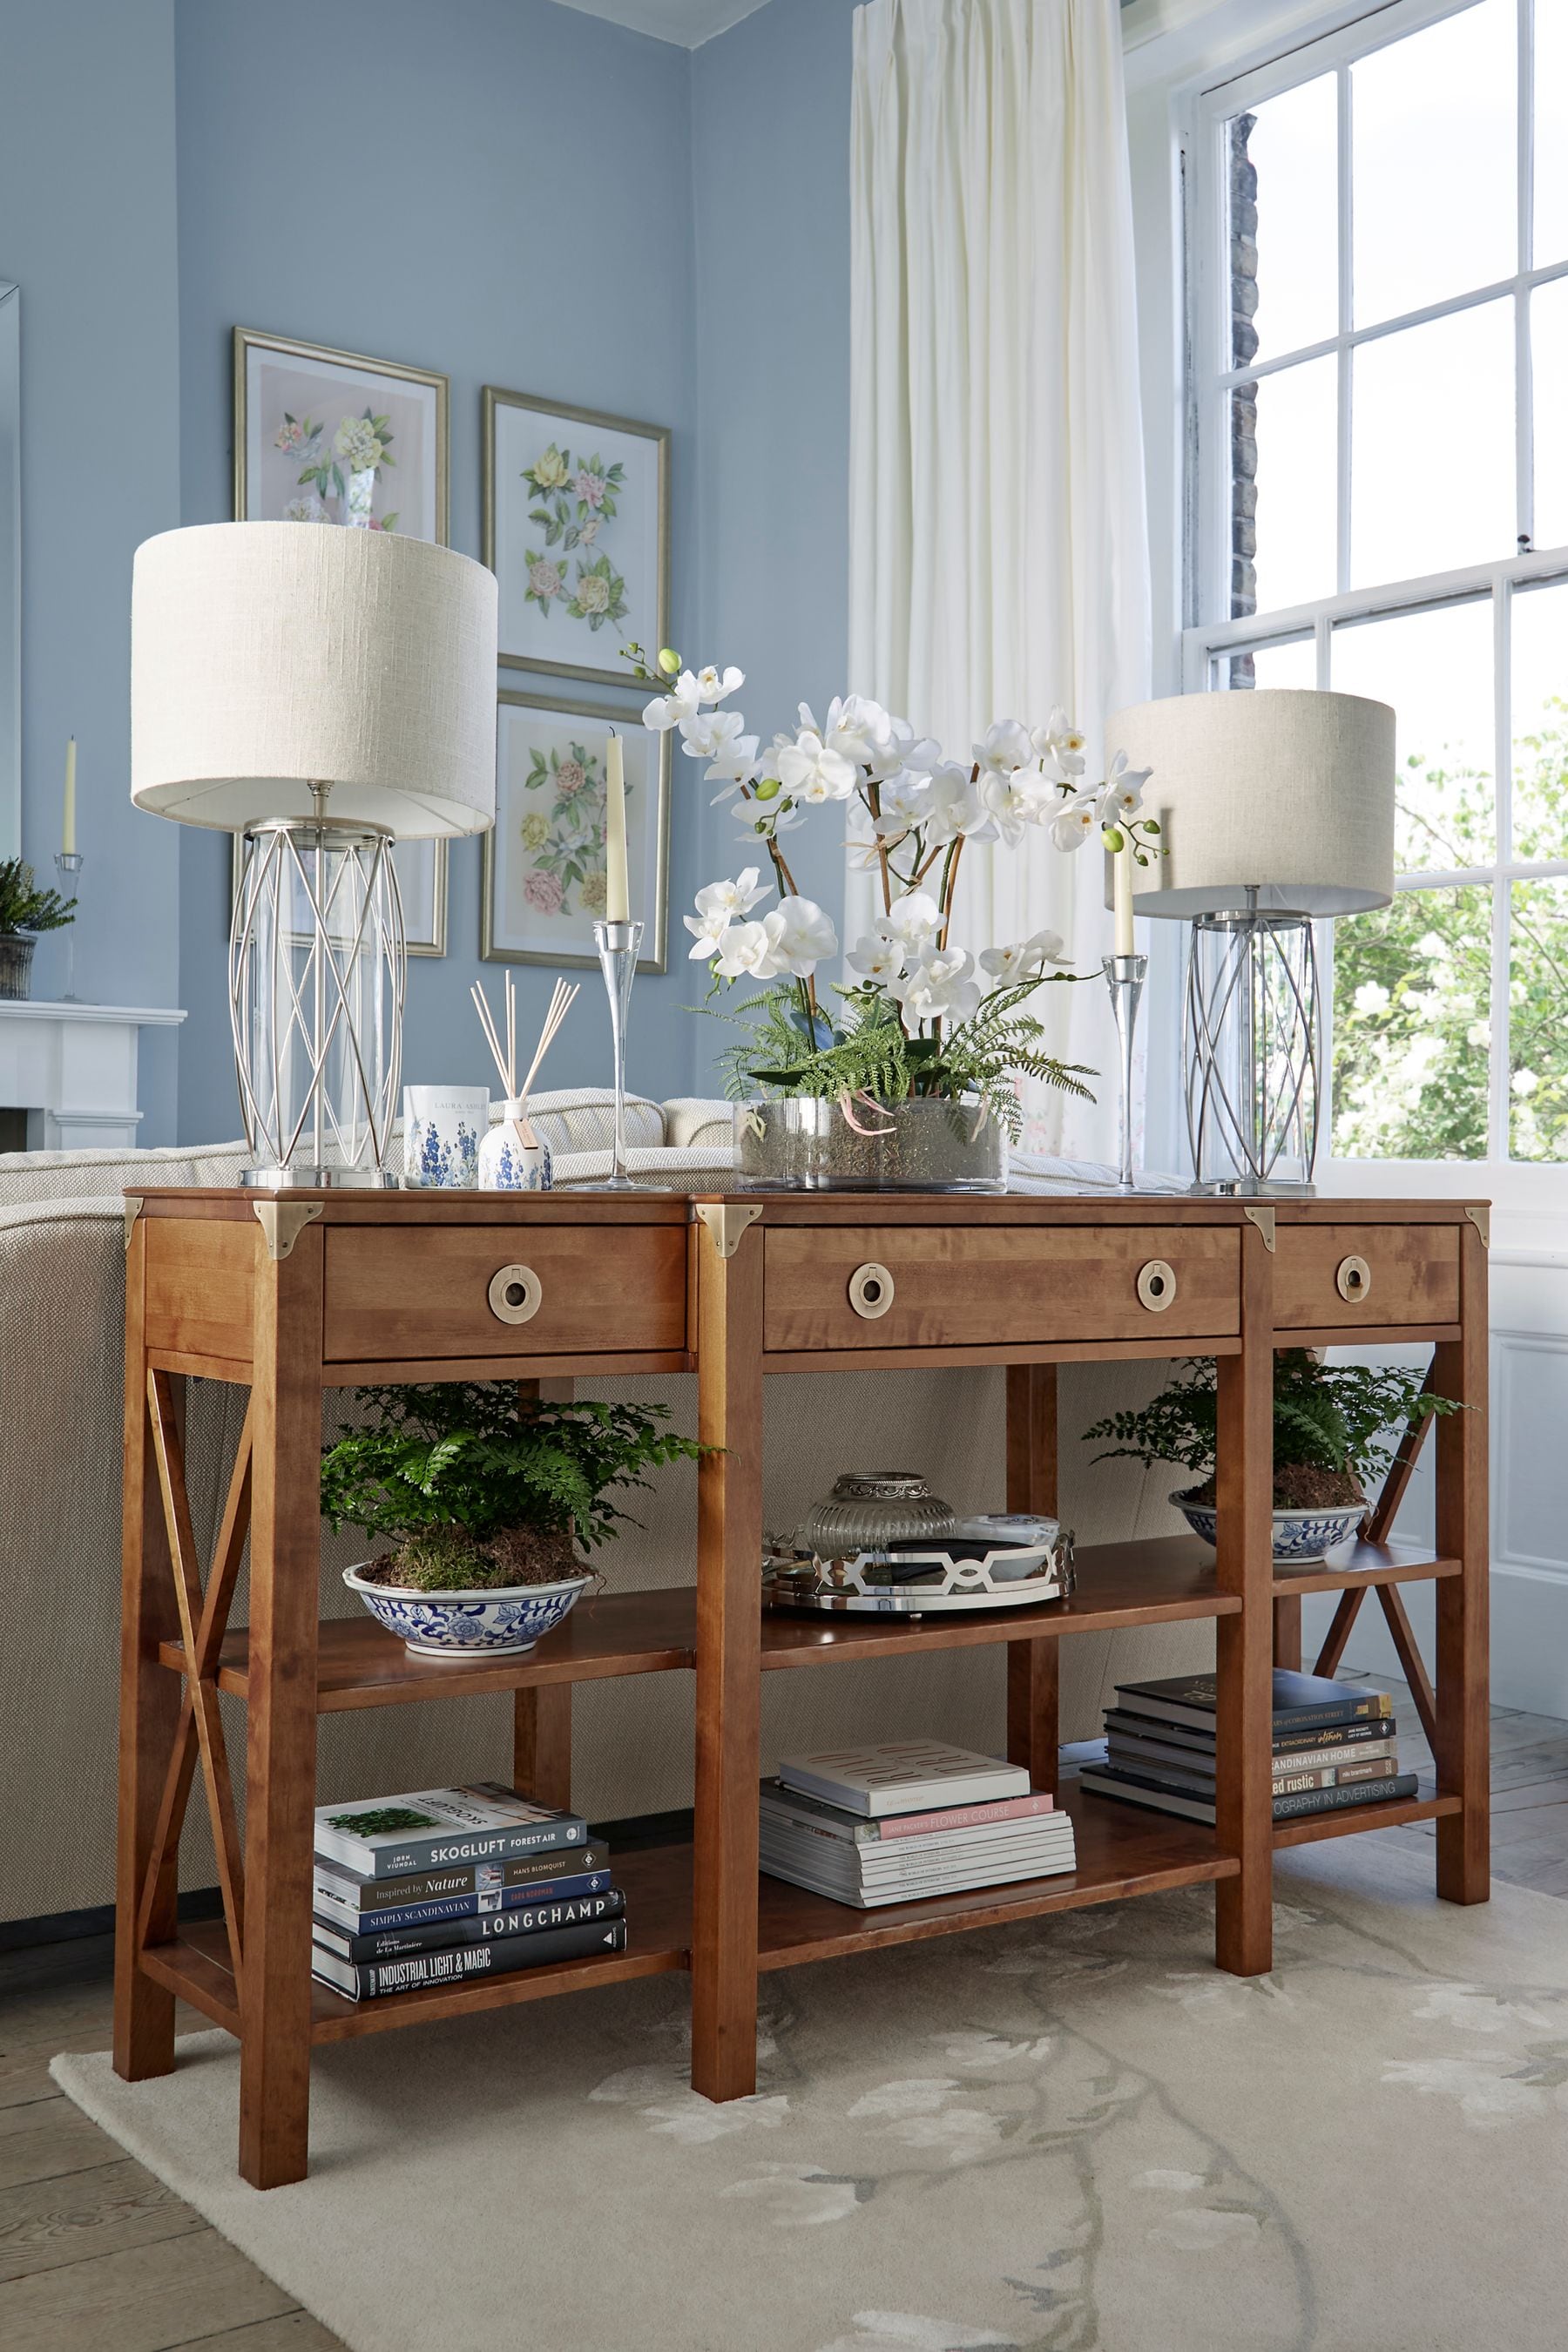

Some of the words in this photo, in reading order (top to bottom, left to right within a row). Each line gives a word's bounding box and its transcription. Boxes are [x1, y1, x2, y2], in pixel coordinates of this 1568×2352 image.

[1330, 1748, 1356, 1761] HOME
[1272, 1779, 1285, 1794] ed
[1288, 1774, 1314, 1791] rustic
[1272, 1794, 1321, 1815] OGRAPHY
[1324, 1794, 1334, 1806] IN
[1336, 1781, 1396, 1803] ADVERTISING
[930, 1812, 969, 1828] FLOWER
[970, 1806, 1010, 1821] COURSE
[430, 1839, 506, 1863] SKOGLUFT
[510, 1835, 541, 1848] FOREST
[542, 1833, 556, 1842] AIR
[513, 1866, 531, 1876] HANS
[531, 1861, 566, 1873] BLOMQUIST
[376, 1885, 411, 1900] Inspired
[412, 1884, 422, 1895] by
[425, 1876, 468, 1893] Nature
[370, 1913, 403, 1927] SIMPLY
[404, 1901, 470, 1921] SCANDINAVIAN
[482, 1900, 605, 1936] LONGCHAMP
[378, 1959, 429, 1987] INDUSTRIAL
[429, 1954, 453, 1978] LIGHT
[455, 1952, 463, 1973] &
[463, 1947, 491, 1971] MAGIC
[395, 1984, 409, 1992] ART
[422, 1974, 463, 1986] INNOVATION
